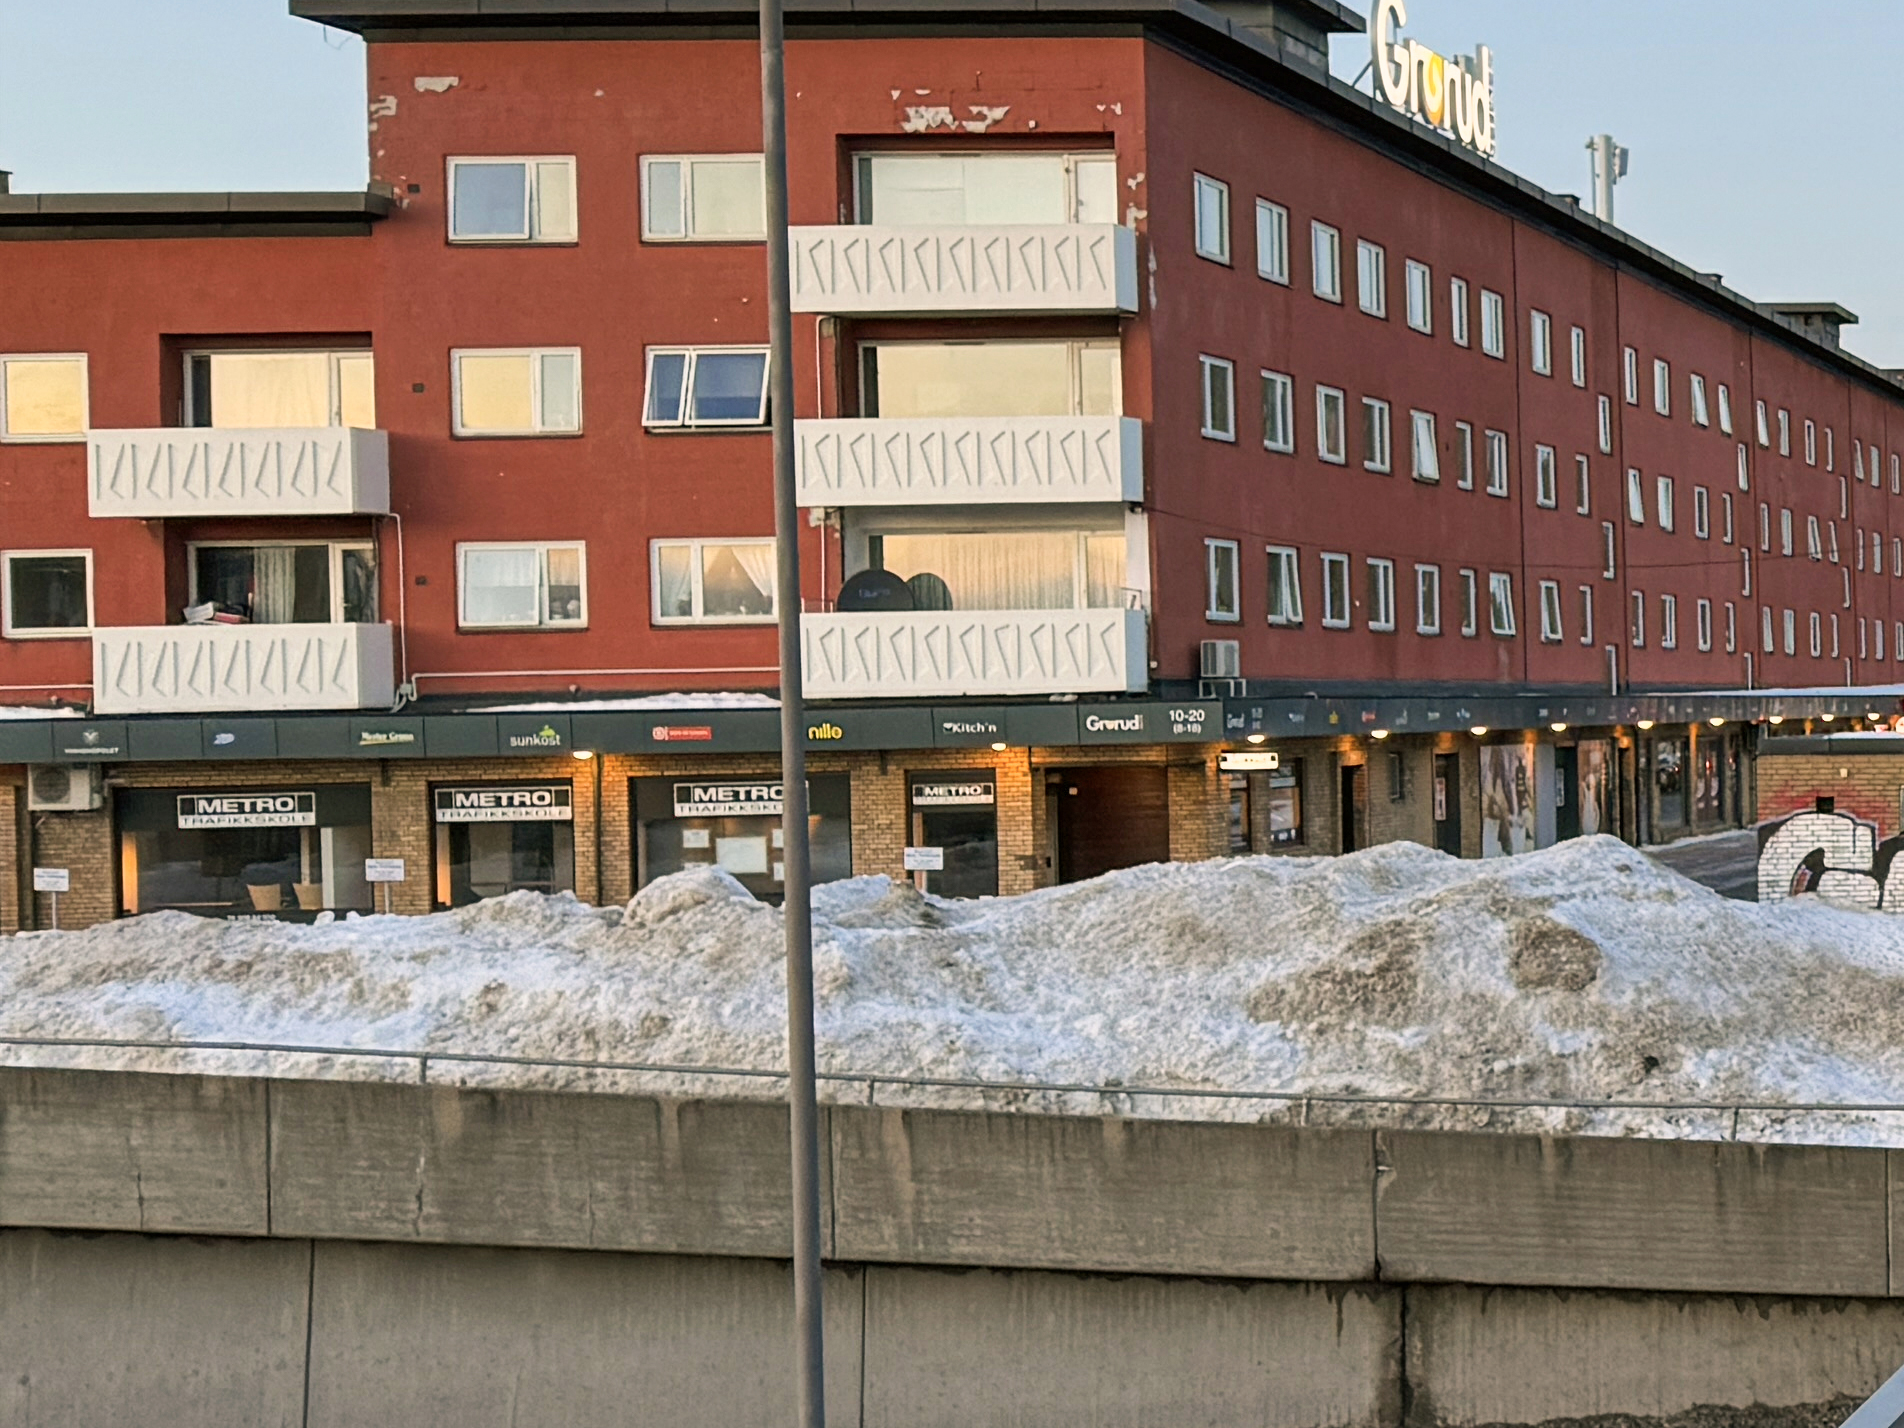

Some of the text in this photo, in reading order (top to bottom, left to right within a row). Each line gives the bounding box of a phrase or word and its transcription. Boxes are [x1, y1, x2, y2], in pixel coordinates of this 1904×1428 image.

[1169, 709, 1205, 722] 10-20
[952, 722, 997, 733] Kitch'n
[509, 733, 561, 746] sunkost
[924, 785, 982, 797] METRO
[198, 796, 295, 814] METRO
[455, 790, 551, 808] METRO
[441, 809, 566, 820] TRAFIKKSKOLE
[679, 804, 784, 815] TRAFIKKSKO
[183, 815, 308, 827] TRAFIKKSKOLE
